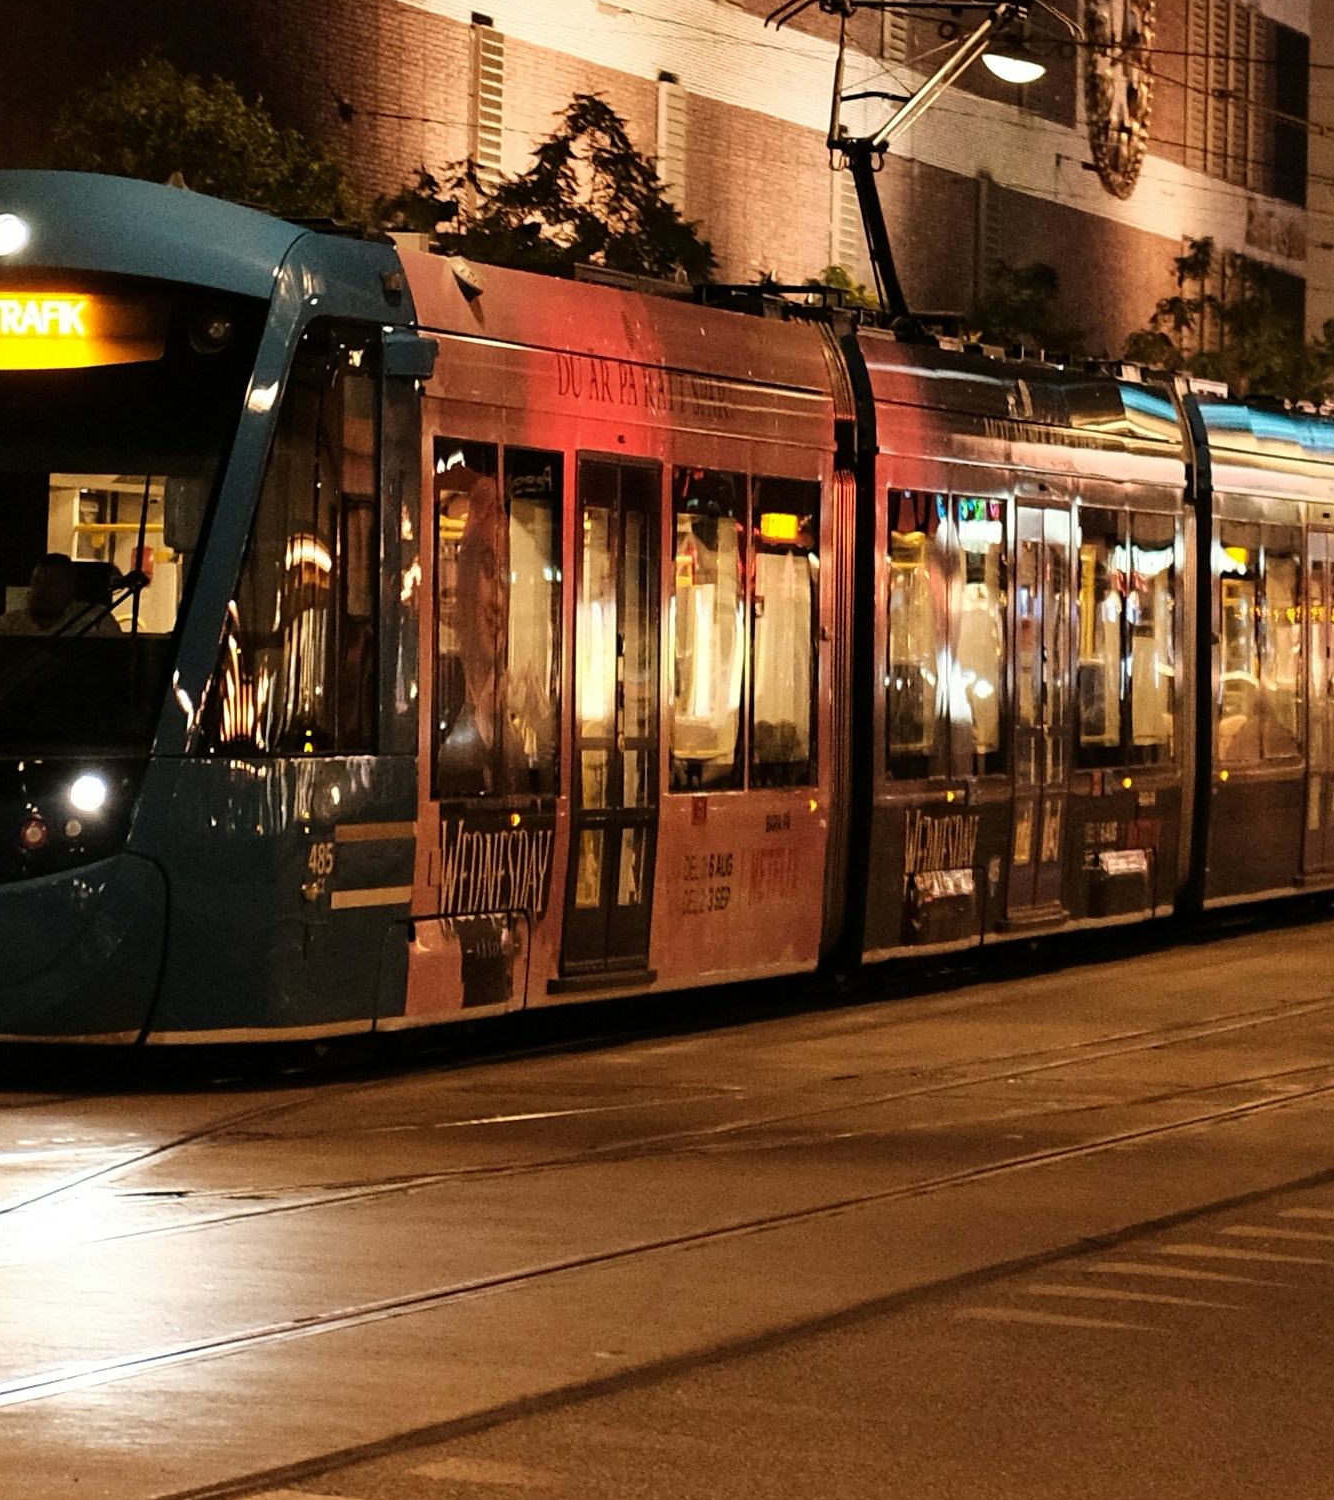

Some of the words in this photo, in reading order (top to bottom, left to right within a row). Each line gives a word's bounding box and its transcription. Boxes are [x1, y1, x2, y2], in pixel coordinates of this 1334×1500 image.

[557, 353, 582, 398] DU
[308, 841, 335, 875] 485
[439, 819, 553, 922] WEDNESDAY
